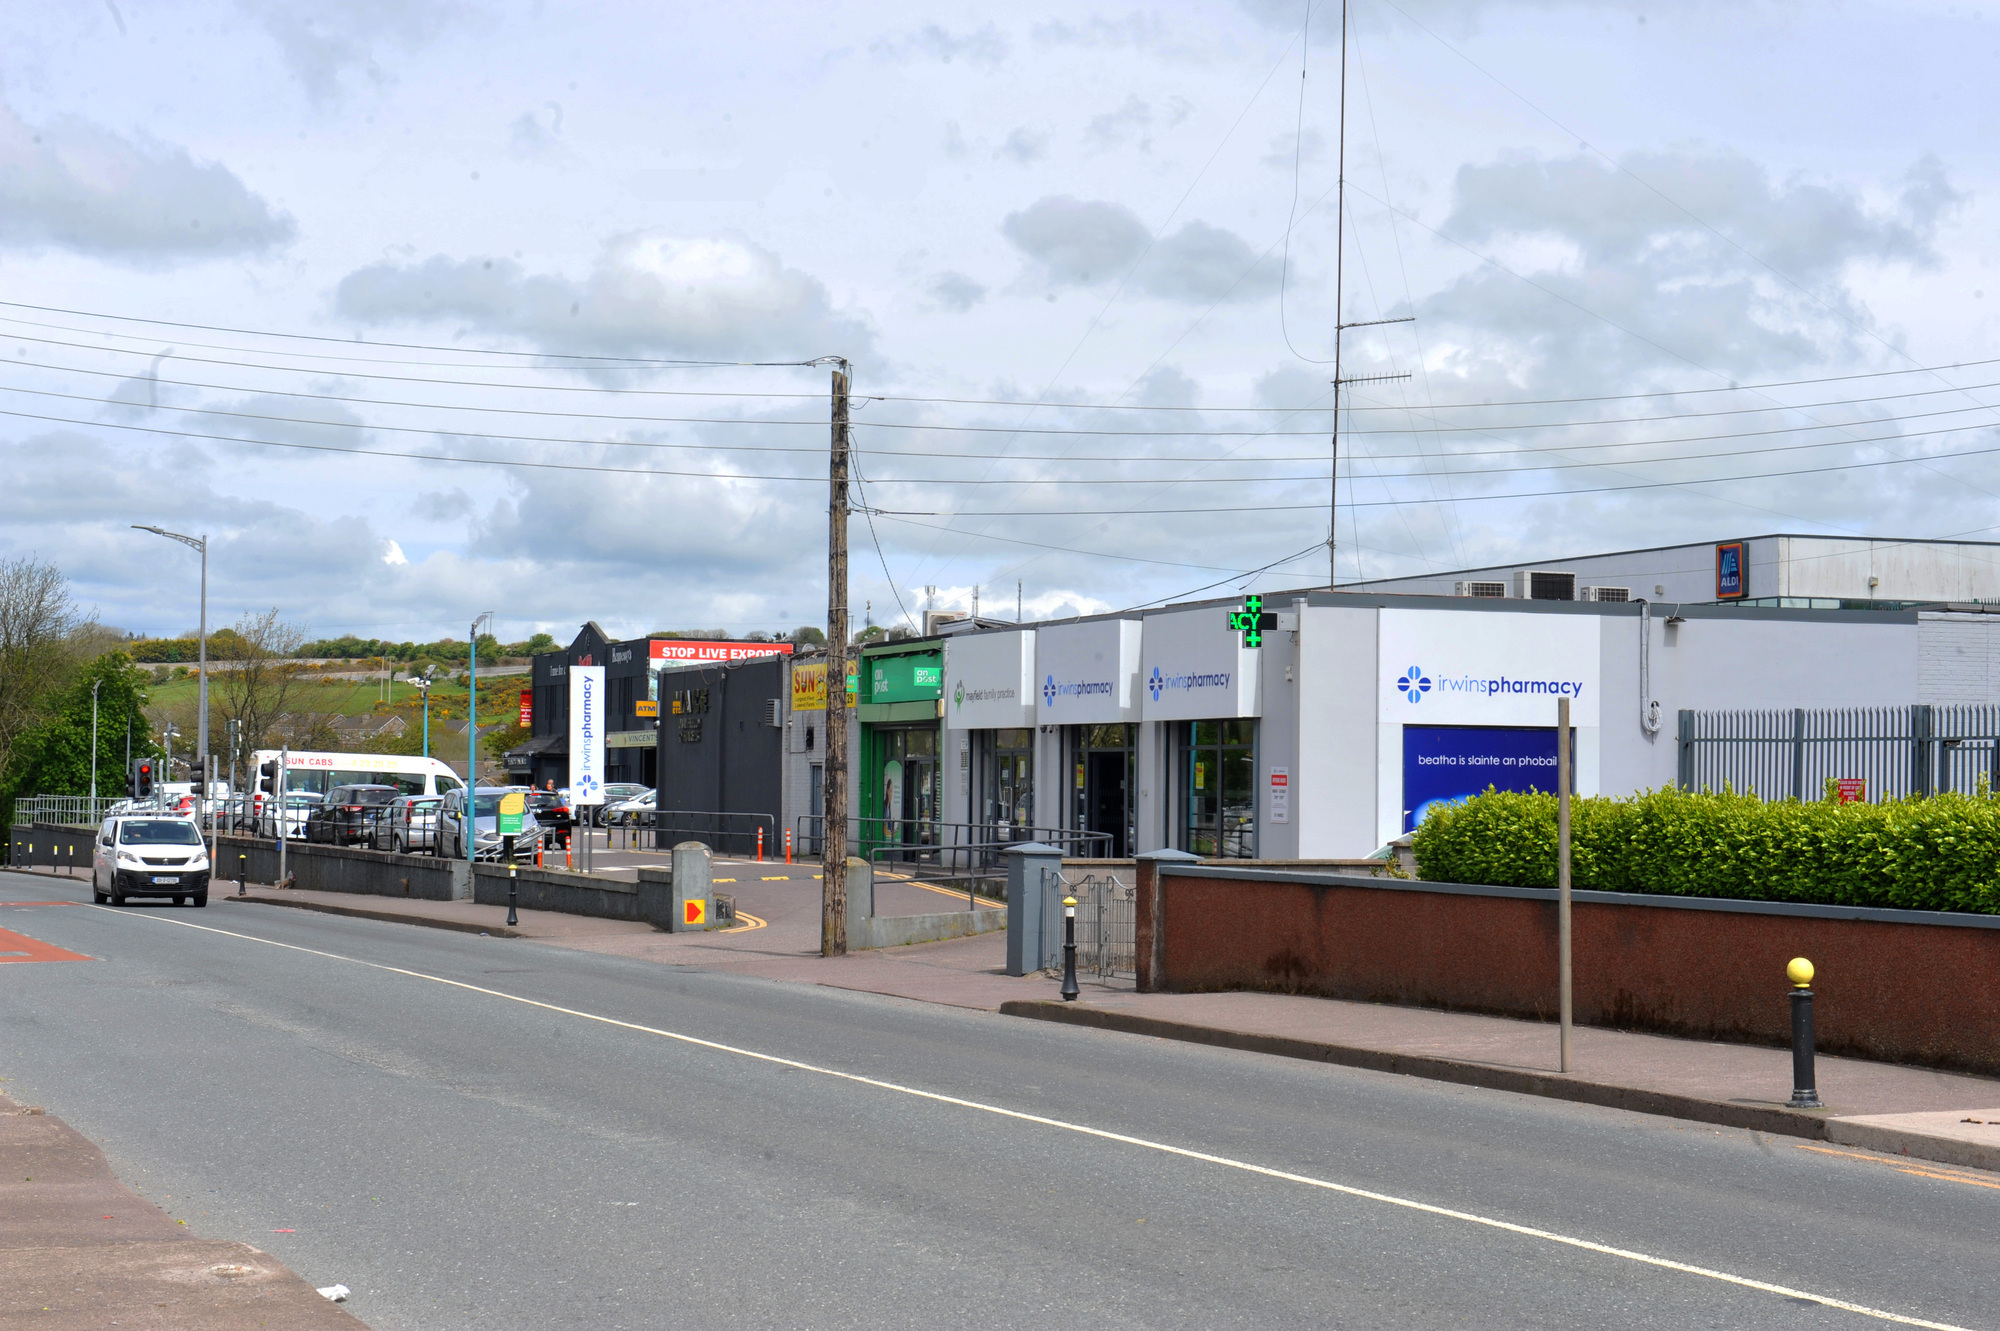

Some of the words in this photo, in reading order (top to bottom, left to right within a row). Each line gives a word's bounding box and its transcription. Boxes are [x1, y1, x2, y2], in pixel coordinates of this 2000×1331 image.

[1721, 577, 1739, 587] ALDI
[662, 646, 696, 658] STOP
[698, 649, 727, 660] LIVE
[874, 669, 883, 681] an
[917, 676, 937, 684] post
[794, 670, 816, 694] SUN
[874, 678, 888, 695] post
[984, 688, 997, 702] family
[997, 687, 1016, 701] practice
[286, 757, 304, 765] SUN
[309, 758, 333, 766] CABS
[1418, 755, 1456, 765] beatha
[1458, 755, 1466, 765] is
[1467, 755, 1500, 766] slainte
[1502, 757, 1517, 766] an
[1518, 756, 1557, 767] phobail
